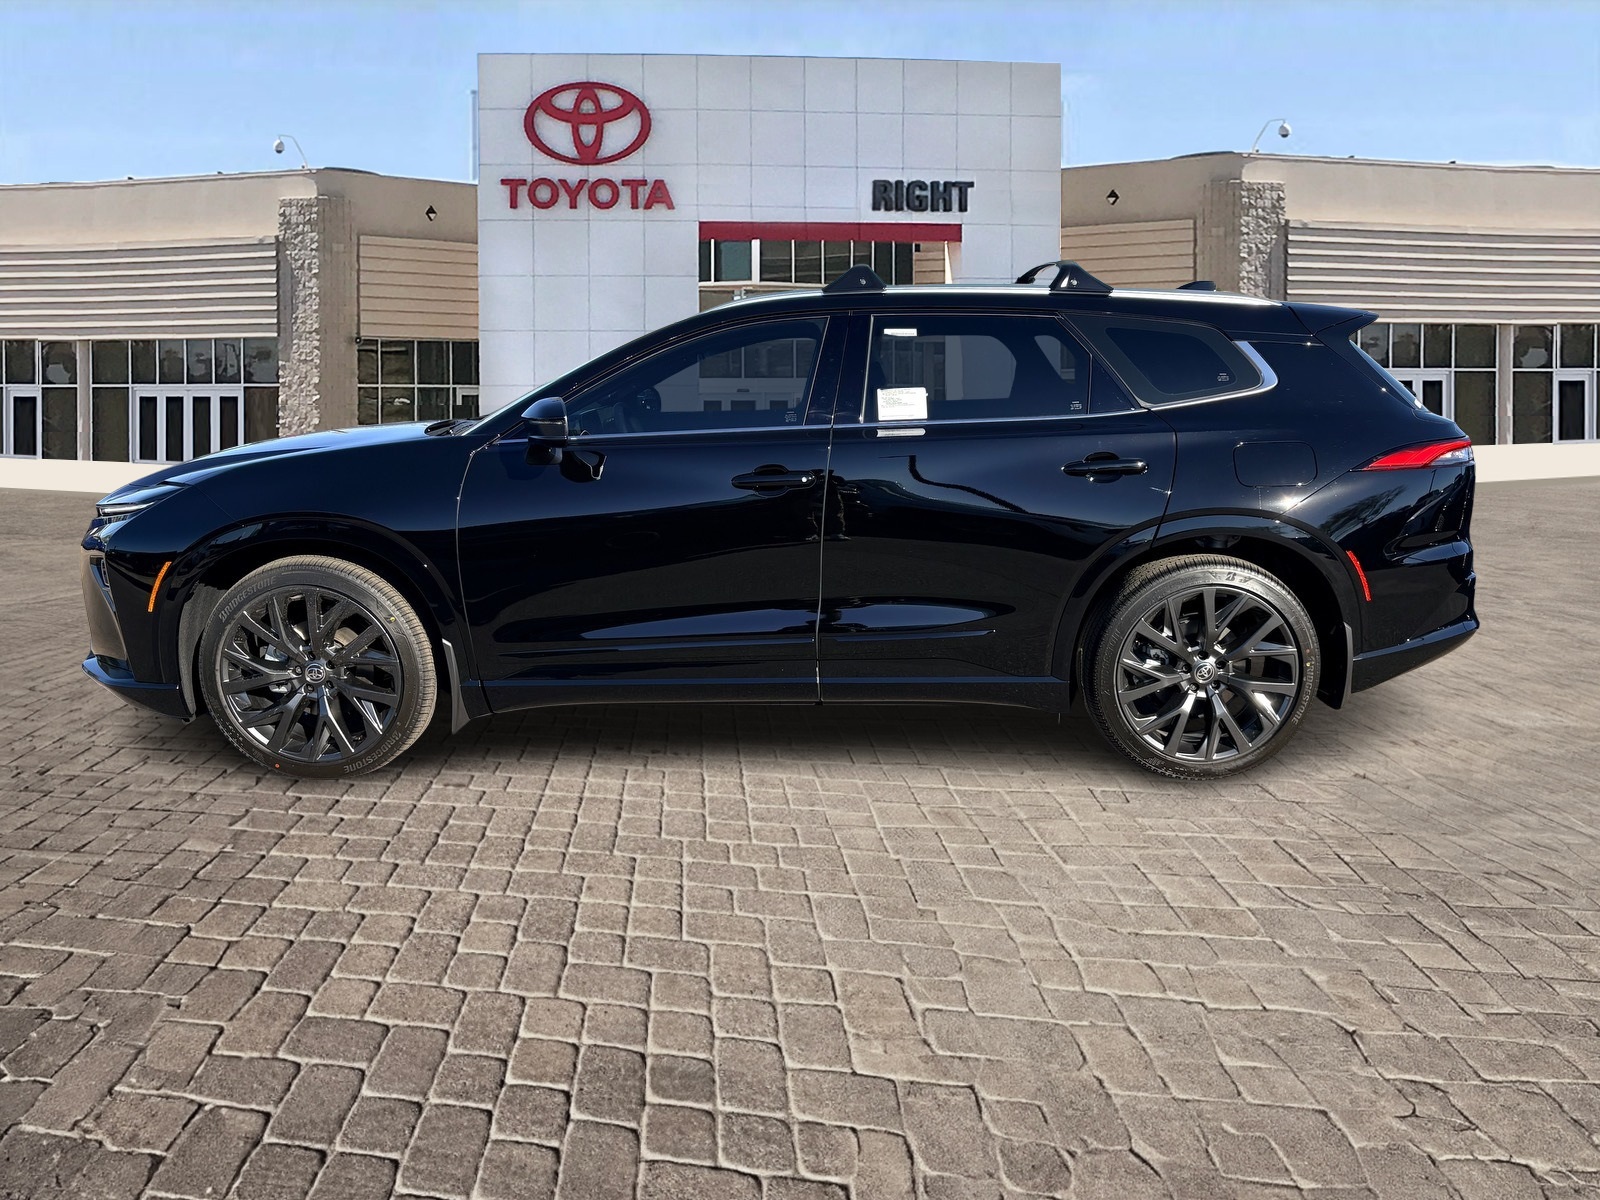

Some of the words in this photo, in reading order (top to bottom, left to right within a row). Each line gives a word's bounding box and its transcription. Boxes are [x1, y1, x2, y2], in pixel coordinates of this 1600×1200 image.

[500, 178, 676, 211] TOYOTA
[871, 179, 976, 213] RIGHT
[218, 575, 278, 624] BRIDGESTONE
[342, 729, 402, 774] BRIDGESTONE
